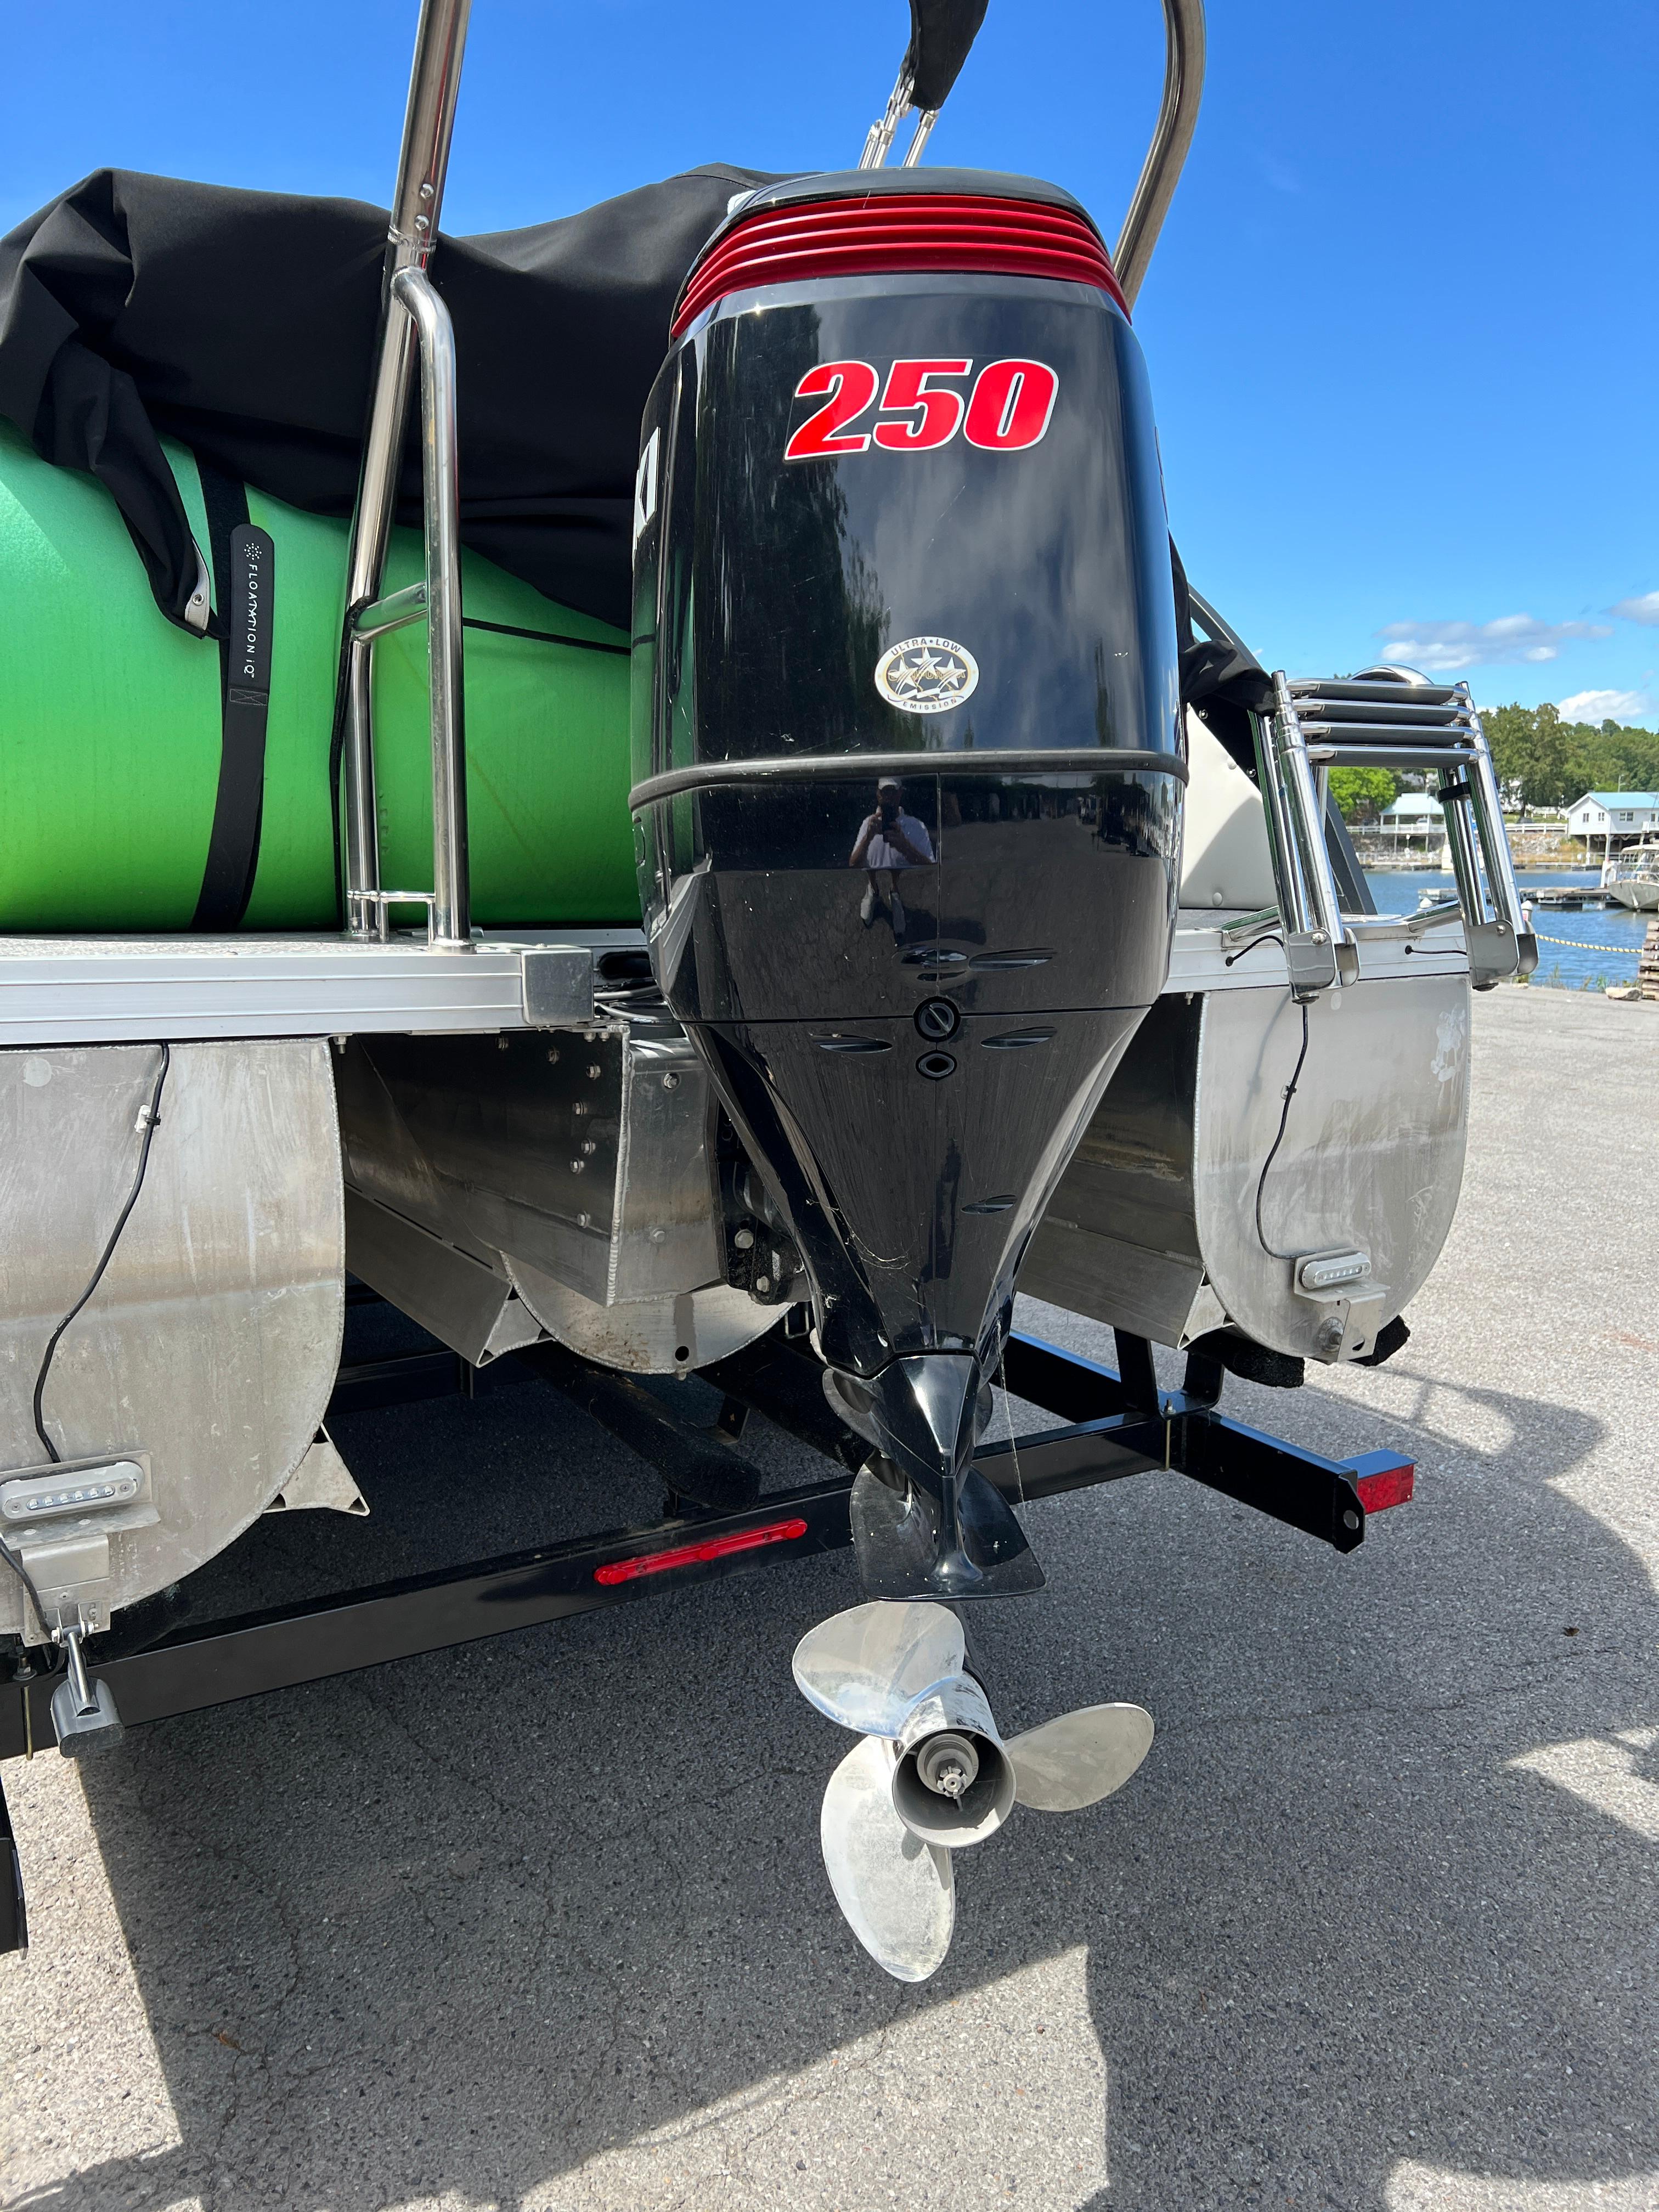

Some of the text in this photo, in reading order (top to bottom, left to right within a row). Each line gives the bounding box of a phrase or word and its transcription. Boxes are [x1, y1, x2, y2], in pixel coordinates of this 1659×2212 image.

[785, 358, 1059, 460] 250
[246, 563, 258, 653] FLOATATION
[903, 698, 957, 710] EMISSION
